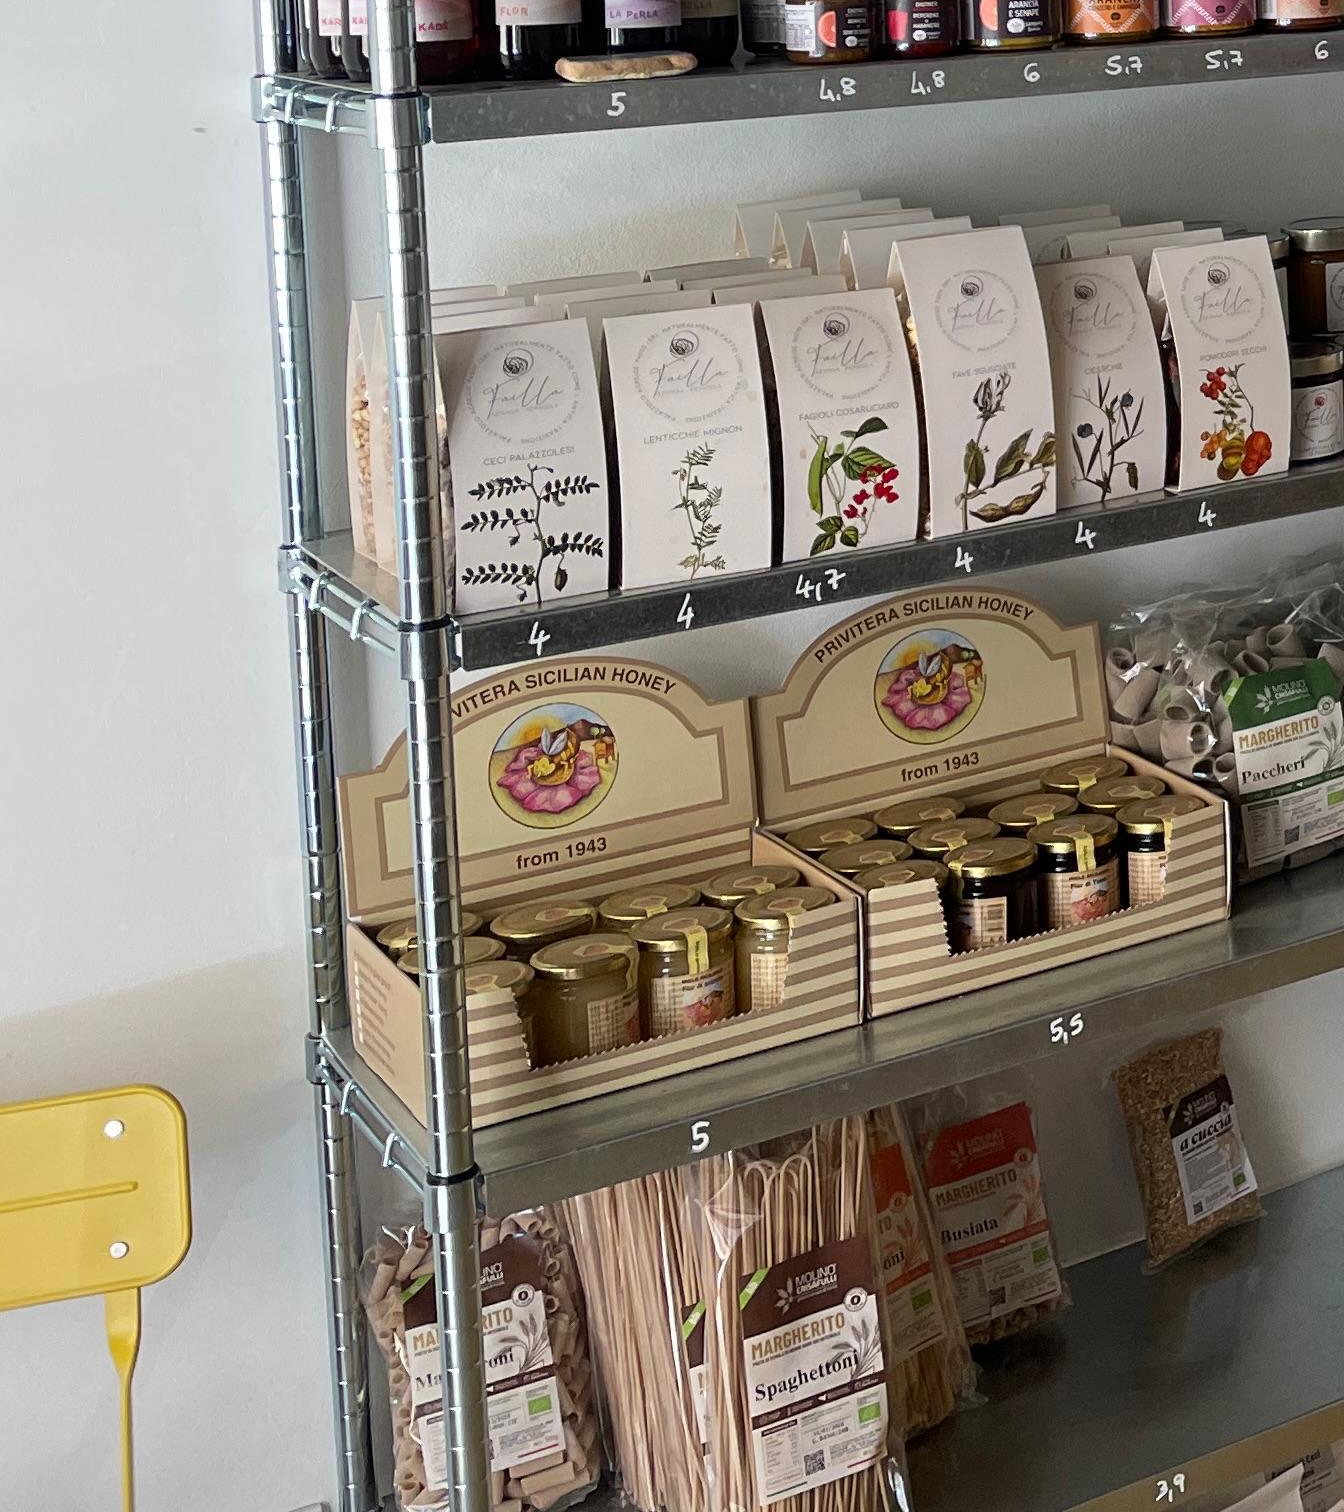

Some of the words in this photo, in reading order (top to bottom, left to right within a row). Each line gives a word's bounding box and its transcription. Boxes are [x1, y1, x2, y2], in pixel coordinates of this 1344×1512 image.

[500, 7, 528, 17] FLOR
[609, 9, 621, 19] LA
[626, 9, 658, 19] PERLA
[1008, 0, 1039, 8] ARANCIA
[1205, 50, 1243, 70] 5,7
[1315, 40, 1329, 60] 6
[1024, 62, 1041, 83] 6
[1104, 55, 1142, 76] 5,7
[819, 77, 856, 103] 4,8
[911, 70, 945, 96] 4,8
[606, 92, 627, 117] 5
[952, 369, 972, 378] FAVE
[799, 411, 833, 422] FAGIOLI
[643, 431, 699, 445] LENTICCHIE
[703, 425, 743, 437] MIGNON
[483, 455, 507, 466] CECI
[510, 446, 575, 463] PALAZZOLESI
[1198, 502, 1217, 527] 4
[1075, 521, 1097, 549] 4
[954, 546, 973, 571] 4
[676, 593, 695, 627] 4
[528, 621, 551, 654] 4
[814, 609, 901, 664] PRIVITERA
[902, 595, 976, 618] SICILIAN
[977, 596, 1036, 622] HONEY
[451, 678, 522, 720] VITERA
[525, 666, 607, 690] SICILIAN
[611, 667, 678, 696] HONEY
[1238, 716, 1319, 749] MARGHERITO
[901, 764, 940, 784] from
[942, 752, 979, 775] 1943
[1242, 756, 1305, 784] Paccheri
[515, 847, 561, 871] from
[564, 836, 607, 859] 1943
[1050, 1012, 1085, 1045] 5,5
[690, 1120, 710, 1153] 5
[1180, 1139, 1188, 1151] a
[935, 1169, 1017, 1207] MARGHERITO
[940, 1217, 999, 1245] Busiata
[795, 1263, 837, 1285] MOLINO
[751, 1312, 846, 1361] MARGHERITO
[754, 1349, 859, 1402] Spaghettoni
